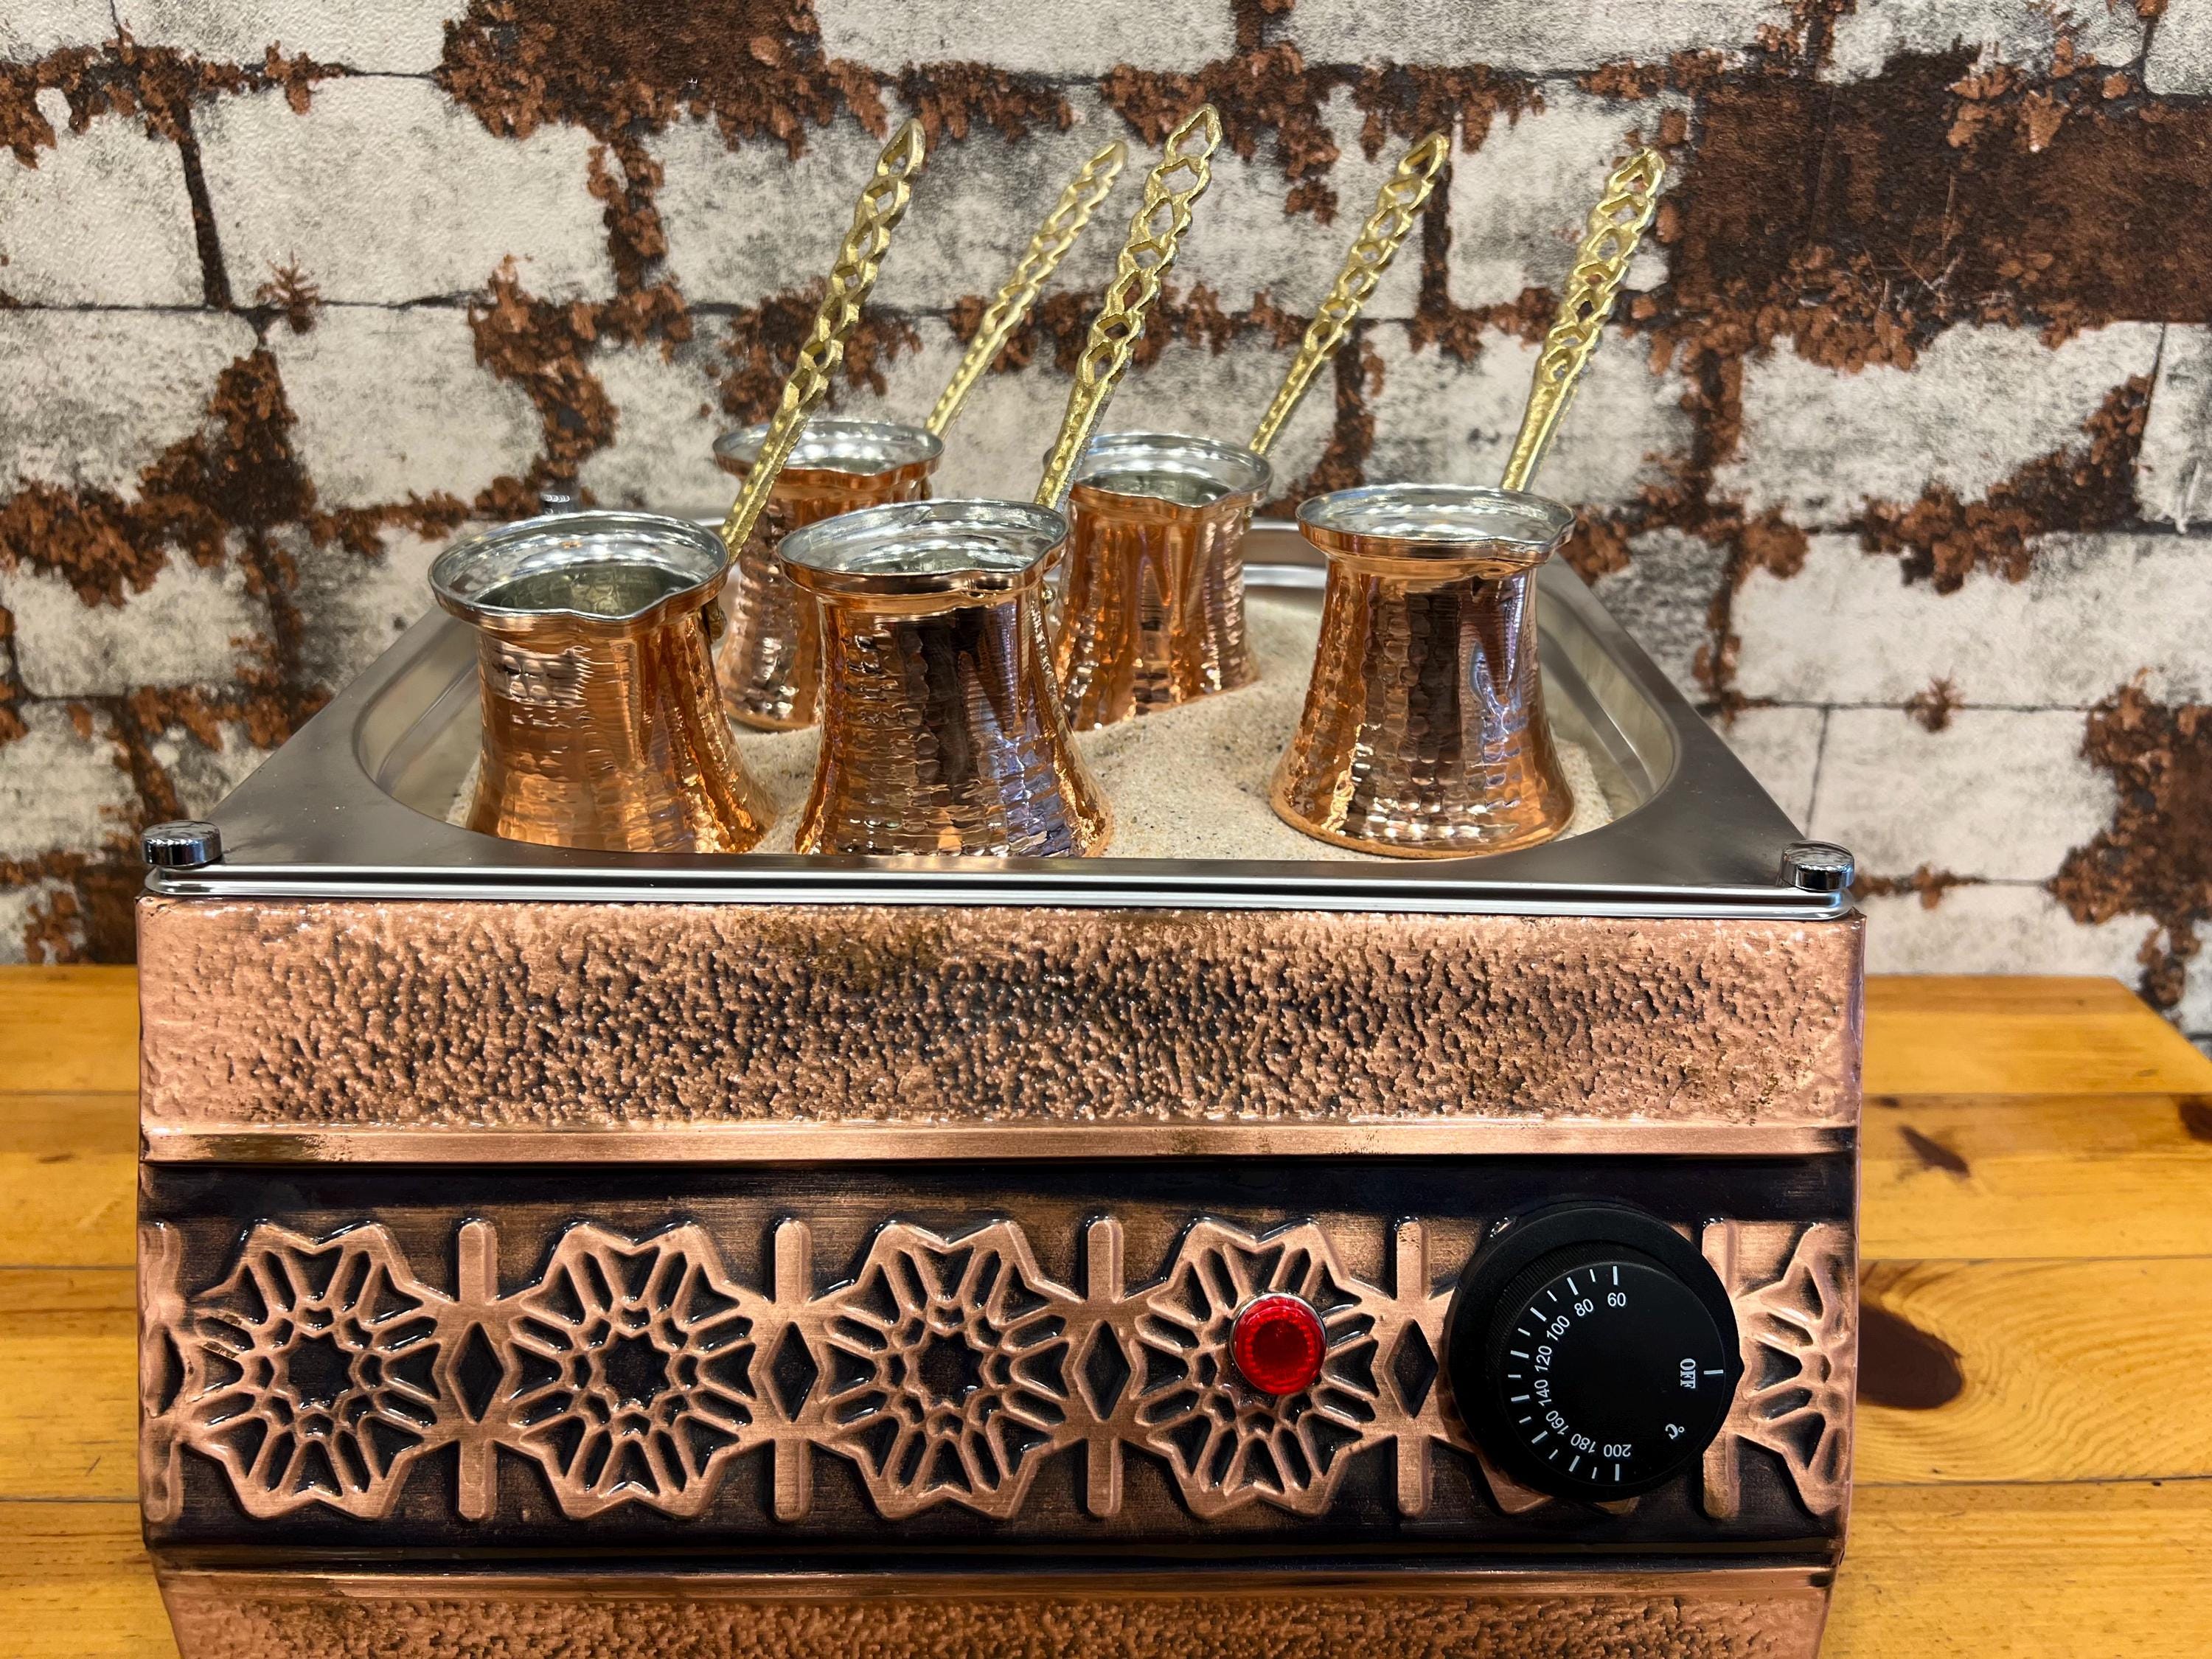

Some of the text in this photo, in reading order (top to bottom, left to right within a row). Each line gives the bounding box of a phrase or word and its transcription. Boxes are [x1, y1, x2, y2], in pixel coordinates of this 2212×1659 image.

[1573, 1298, 1594, 1317] 80
[1607, 1292, 1627, 1307] 60
[1547, 1315, 1571, 1341] 100
[1534, 1345, 1553, 1372] 120
[1680, 1357, 1697, 1389] OFF
[1534, 1379, 1552, 1407] 140
[1545, 1410, 1570, 1436] 160
[1570, 1433, 1597, 1454] 180
[1603, 1444, 1632, 1458] 200
